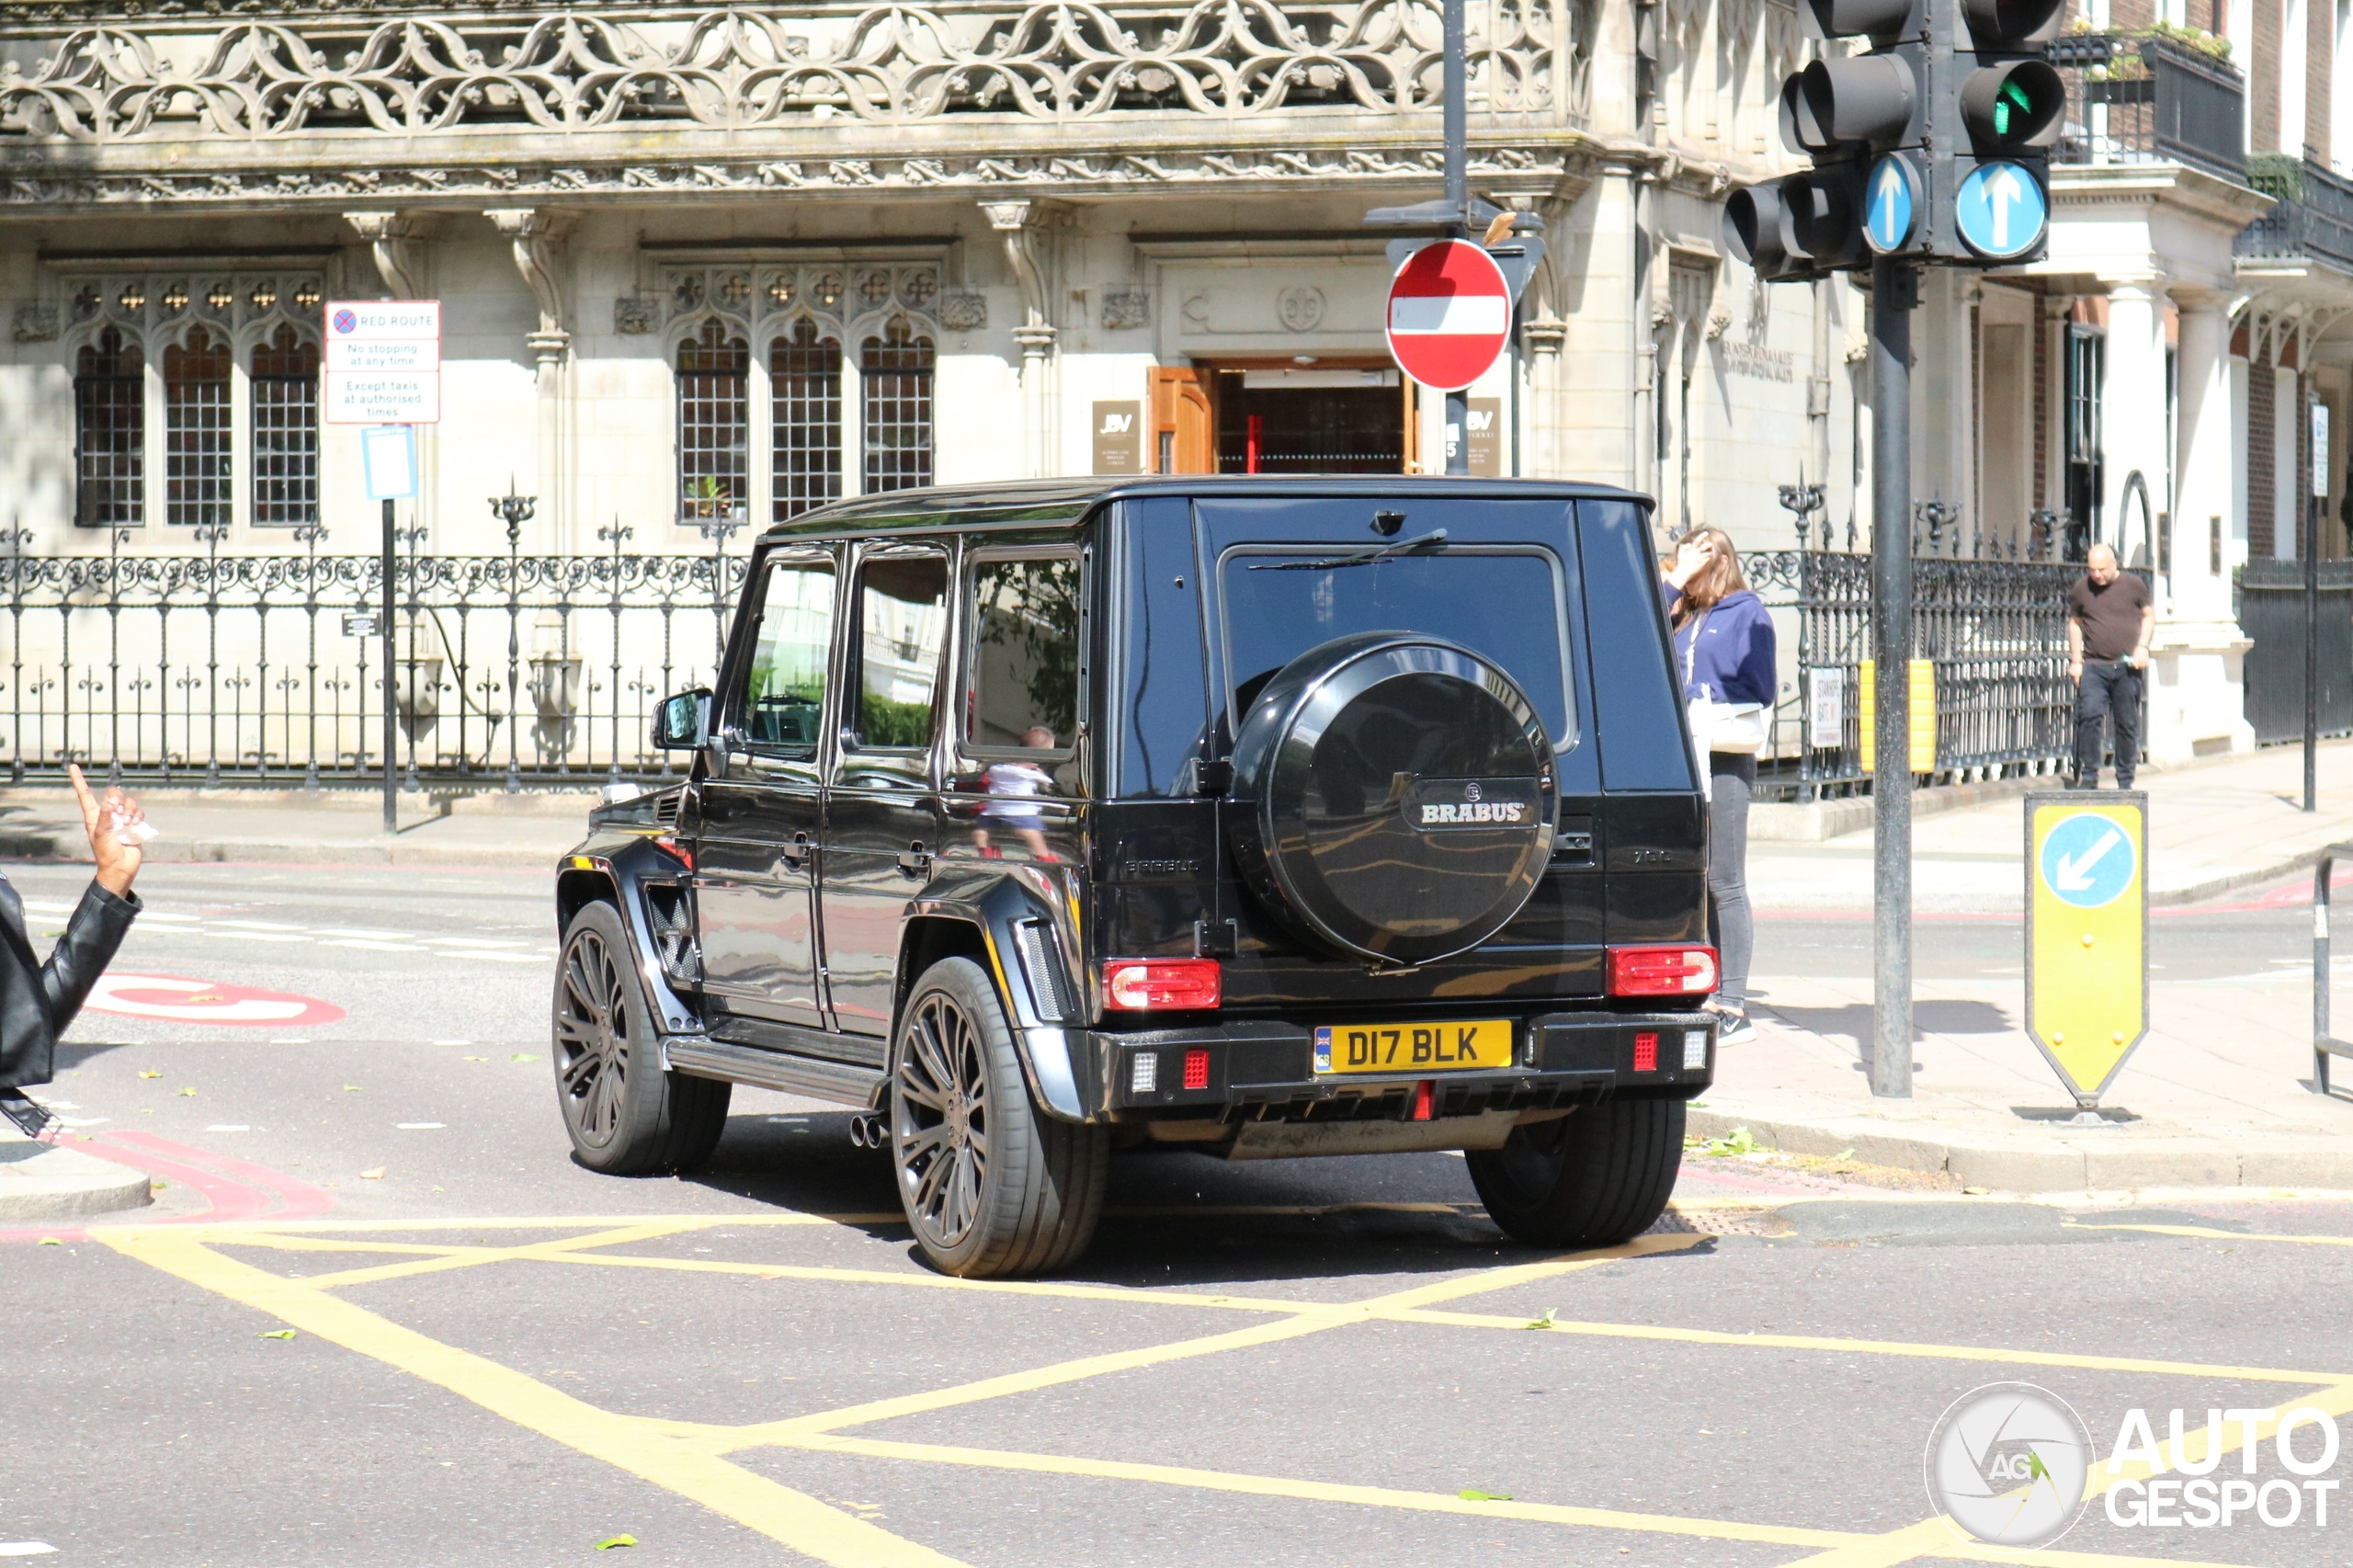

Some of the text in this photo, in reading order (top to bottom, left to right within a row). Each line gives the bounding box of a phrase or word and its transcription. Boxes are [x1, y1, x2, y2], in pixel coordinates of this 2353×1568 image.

[360, 315, 434, 326] RED ROUTE
[347, 344, 418, 355] No stopping
[350, 357, 415, 368] at any time
[347, 381, 418, 392] Except taxis
[344, 393, 422, 403] at authorised
[367, 407, 399, 417] times
[1421, 802, 1522, 824] BRABUS
[1125, 859, 1199, 872] BRABUS
[1347, 1027, 1478, 1066] D17 BLK
[1316, 1053, 1331, 1067] GB
